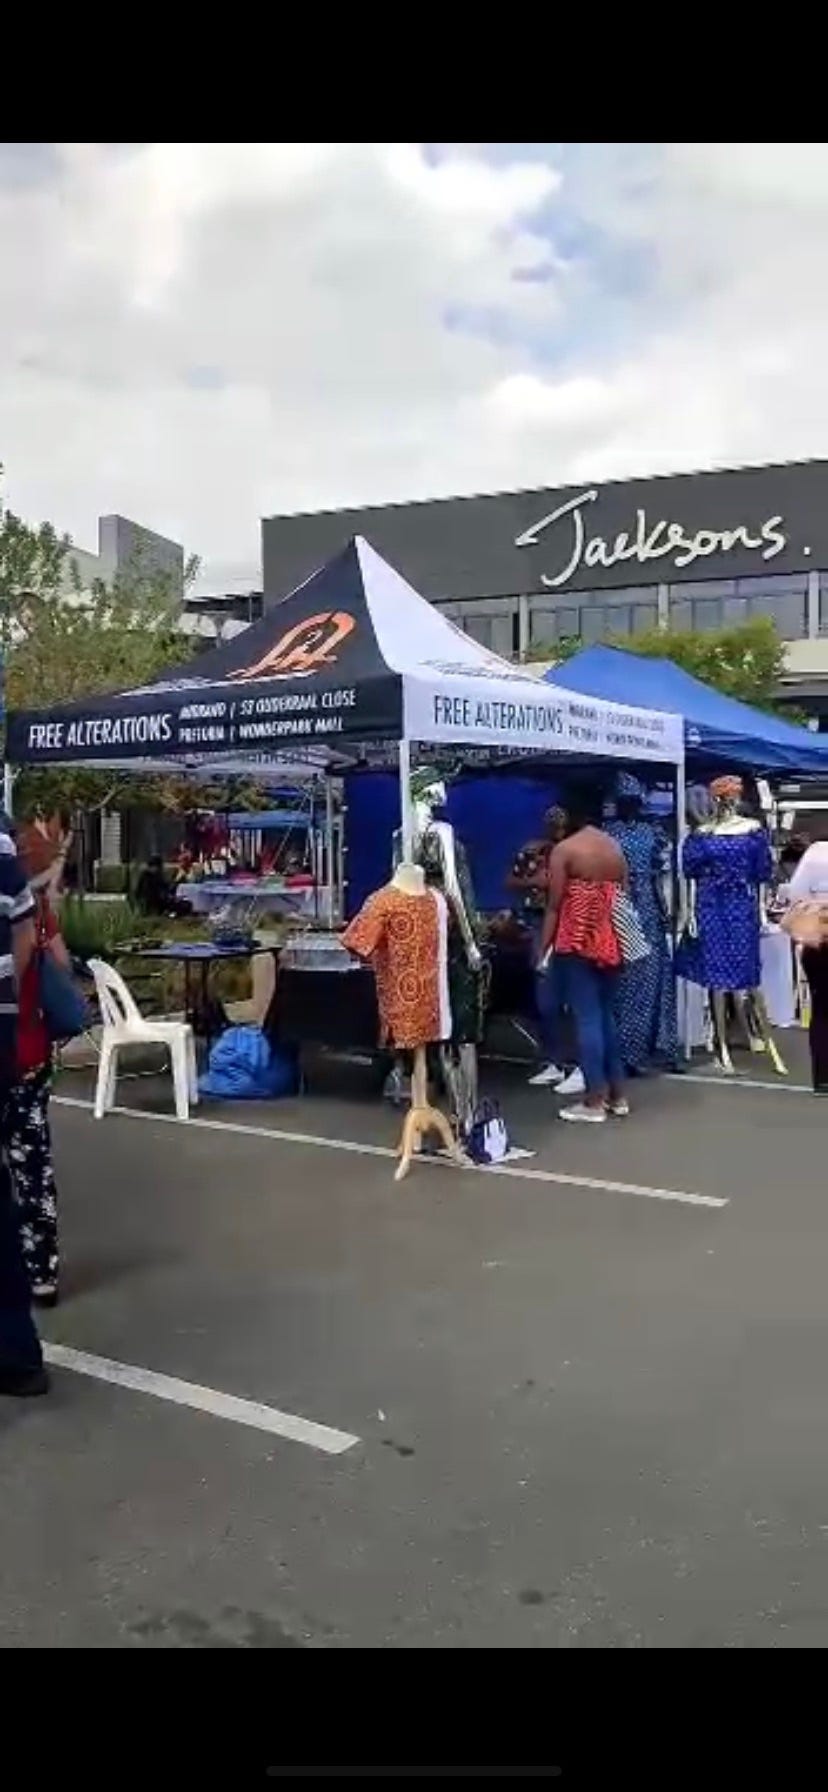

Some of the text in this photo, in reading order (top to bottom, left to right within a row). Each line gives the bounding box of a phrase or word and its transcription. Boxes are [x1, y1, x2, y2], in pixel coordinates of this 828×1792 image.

[322, 689, 357, 708] CLOSE
[315, 716, 344, 733] MALL
[433, 695, 470, 727] FREE
[475, 702, 564, 734] ALTERATIONS
[28, 714, 173, 749] FREE ALTERATIONS
